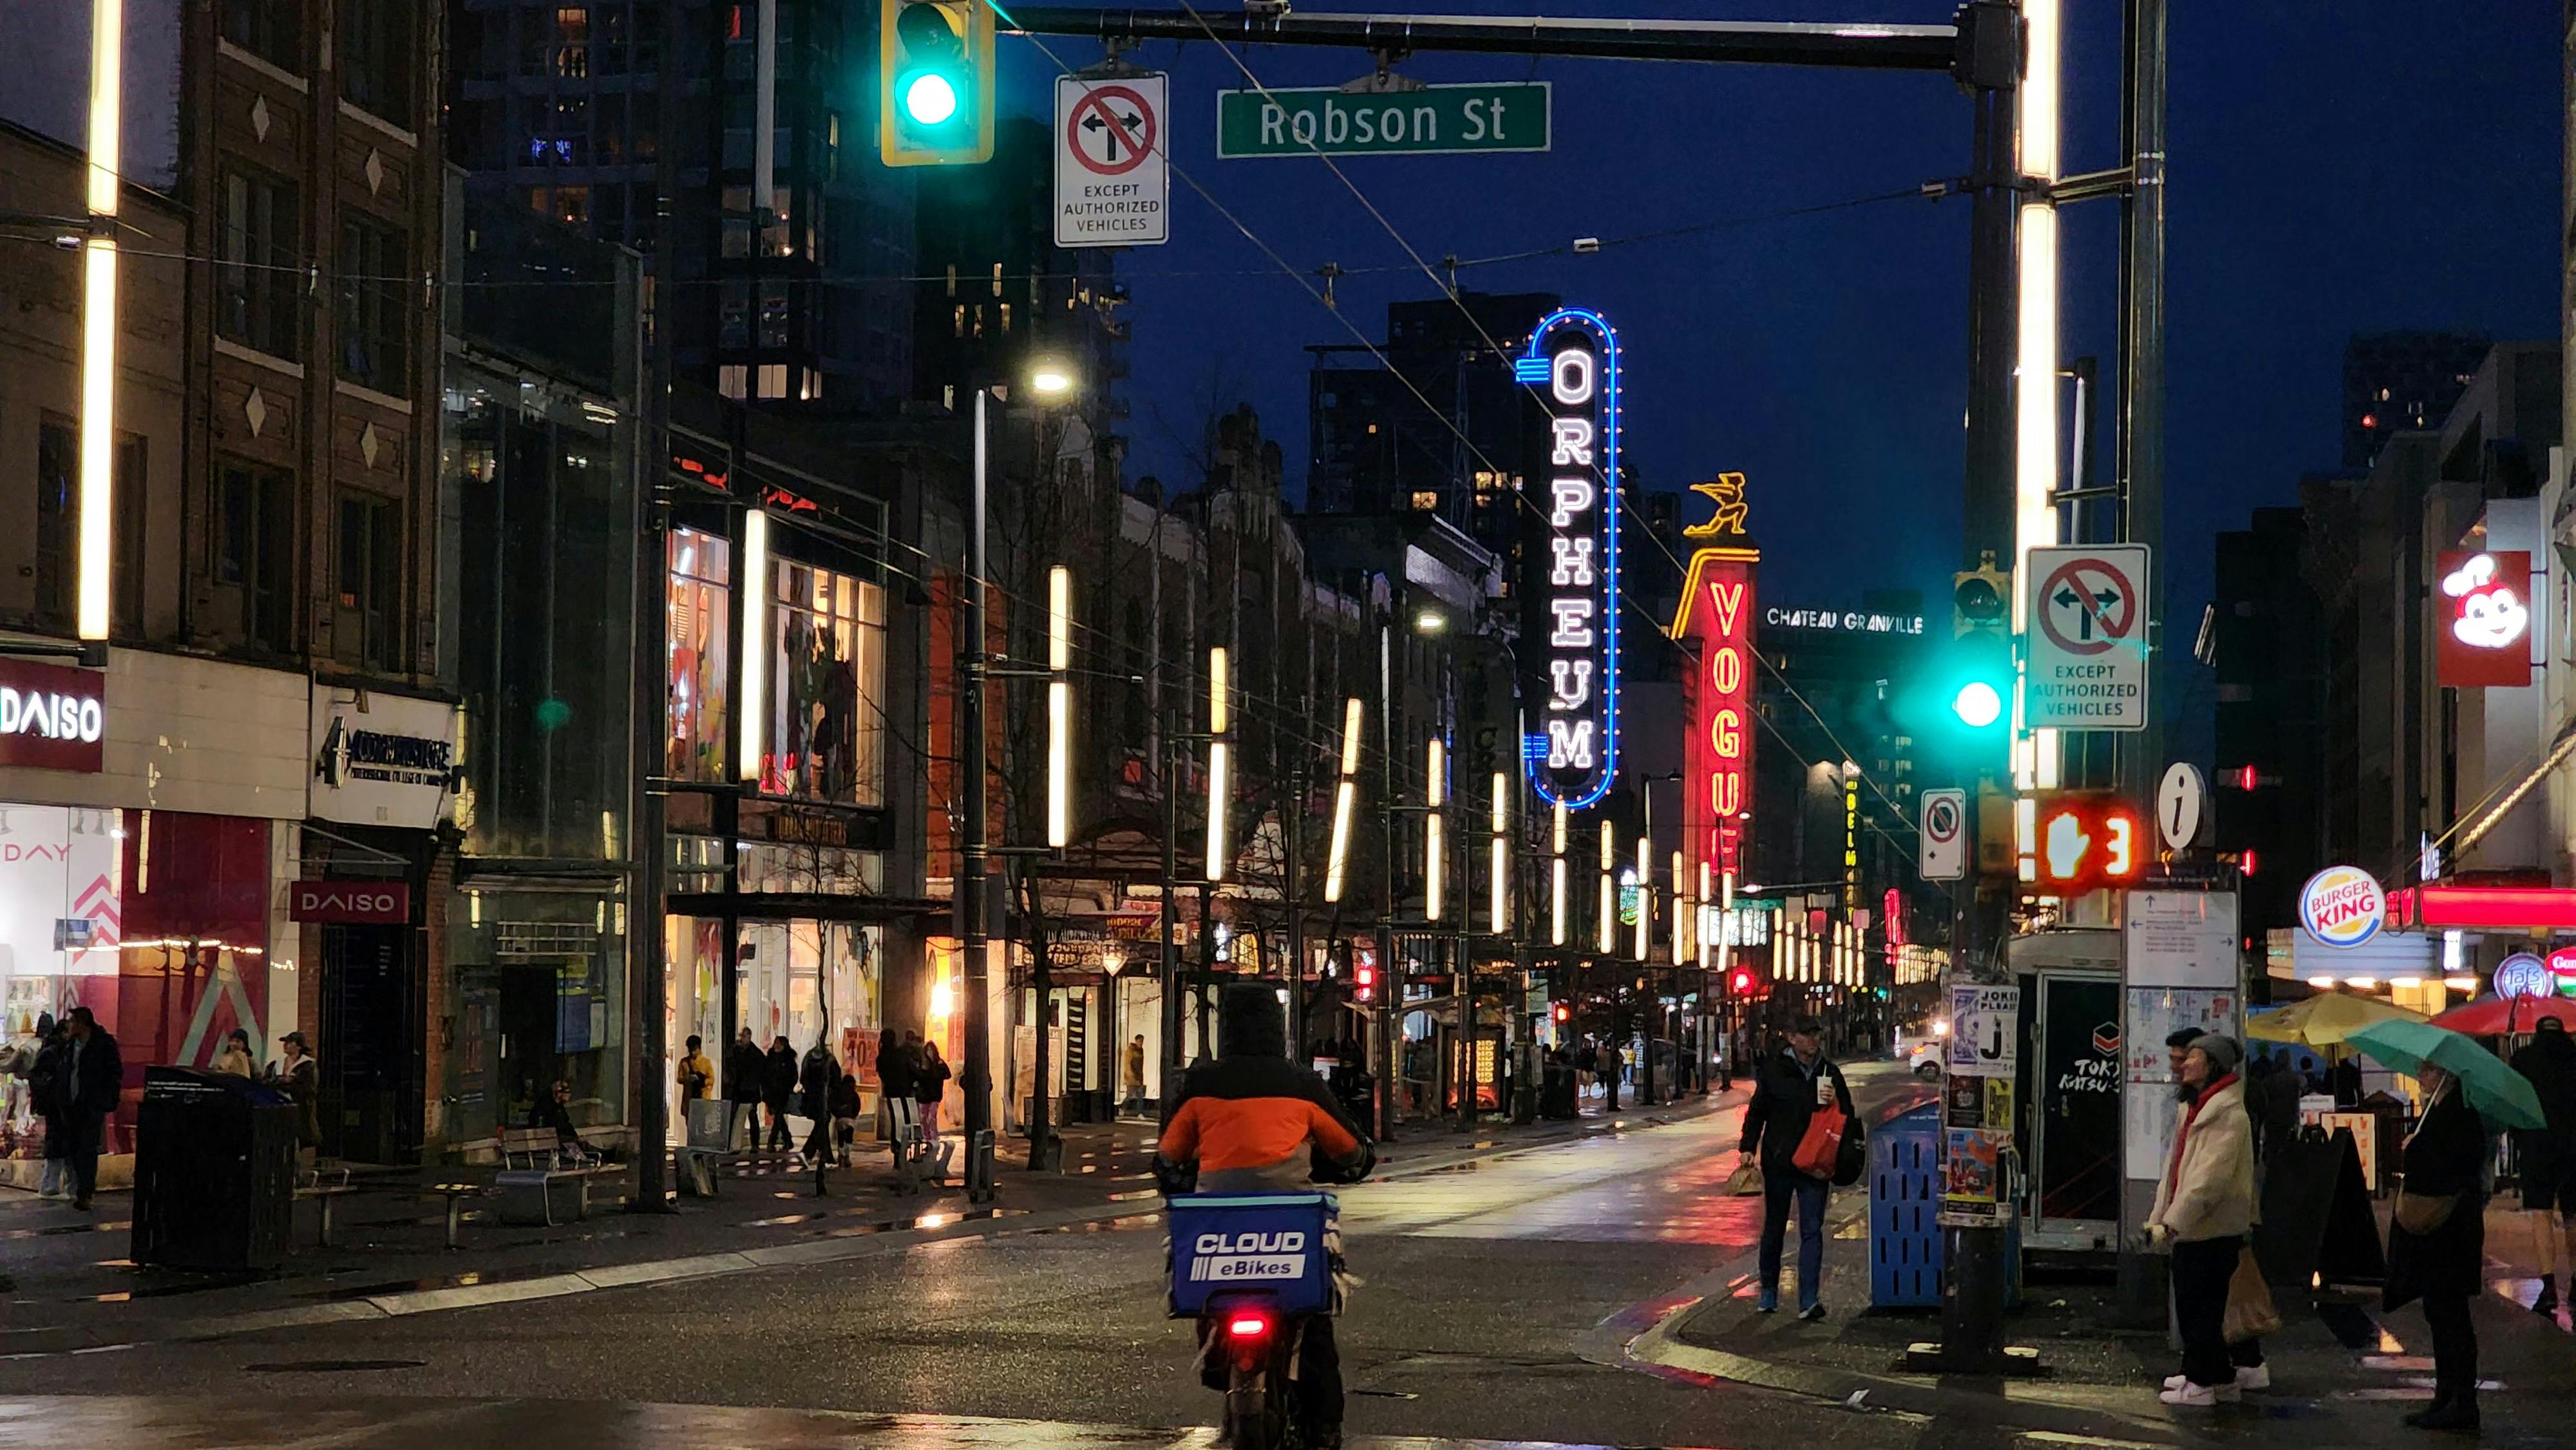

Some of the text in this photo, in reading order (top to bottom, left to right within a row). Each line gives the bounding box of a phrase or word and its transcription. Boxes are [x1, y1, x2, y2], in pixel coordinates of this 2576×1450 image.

[1261, 97, 1506, 145] Robson St
[1084, 184, 1140, 198] EXCEPT
[1064, 200, 1159, 215] AUTHORIZED
[1076, 218, 1147, 232] VEHICLES
[1548, 349, 1594, 769] ORPHEUM
[1766, 607, 1924, 634] CHATEAU GRANVILLE
[2055, 665, 2116, 679] EXCEPT
[2033, 684, 2137, 697] AUTHORIZED
[0, 686, 102, 743] DAISO
[2046, 702, 2124, 716] VEHICLES
[301, 893, 395, 912] DAISO
[2311, 880, 2372, 913] BURGER
[2316, 893, 2376, 932] KING
[1195, 1231, 1305, 1254] CLOUD
[1220, 1260, 1292, 1276] eBikes
